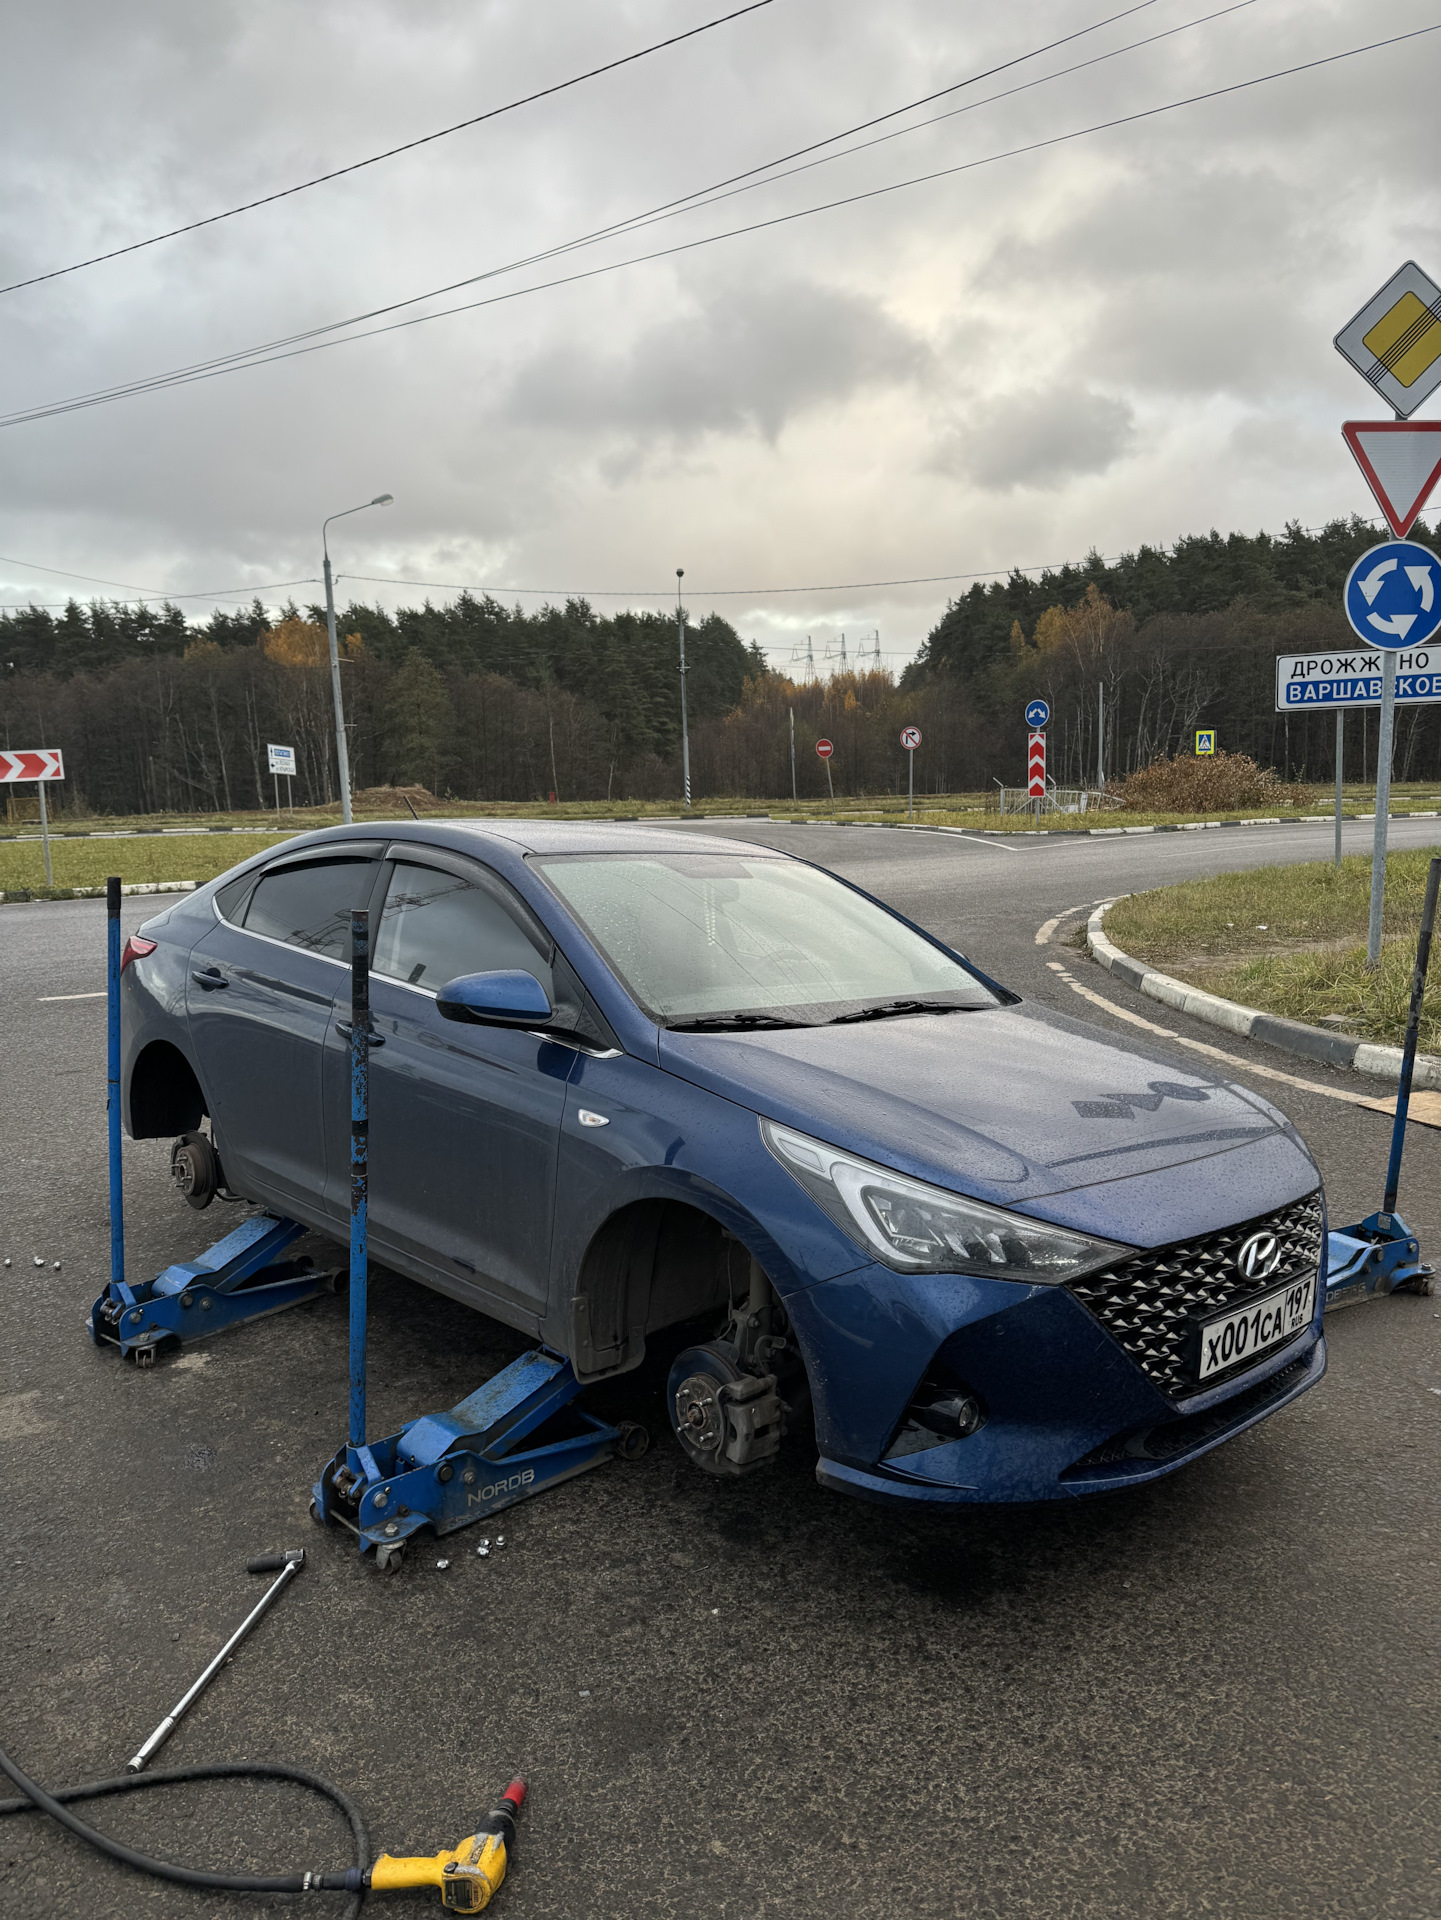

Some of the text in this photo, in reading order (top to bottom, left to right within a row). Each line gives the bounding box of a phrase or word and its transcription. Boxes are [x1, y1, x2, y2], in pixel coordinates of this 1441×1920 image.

[1290, 652, 1430, 680] ДРОЖЖНО
[1288, 676, 1441, 702] ВАРШАВКОЕ
[1287, 1280, 1311, 1318] 197
[1290, 1313, 1304, 1330] RUS
[467, 1468, 535, 1507] NORDB
